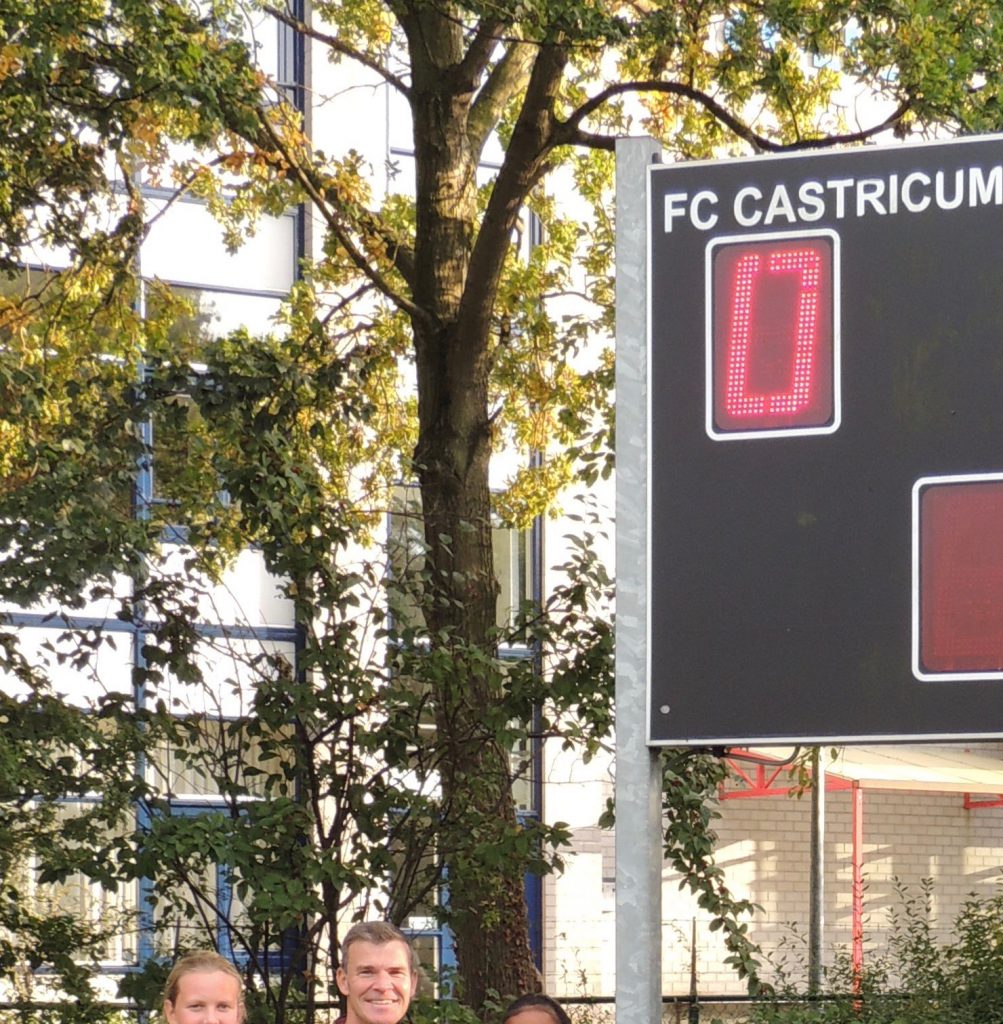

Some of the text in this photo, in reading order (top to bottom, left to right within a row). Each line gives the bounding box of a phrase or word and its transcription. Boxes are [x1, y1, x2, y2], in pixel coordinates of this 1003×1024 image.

[663, 165, 1003, 234] FC CASTRICUM
[723, 248, 823, 416] 0
